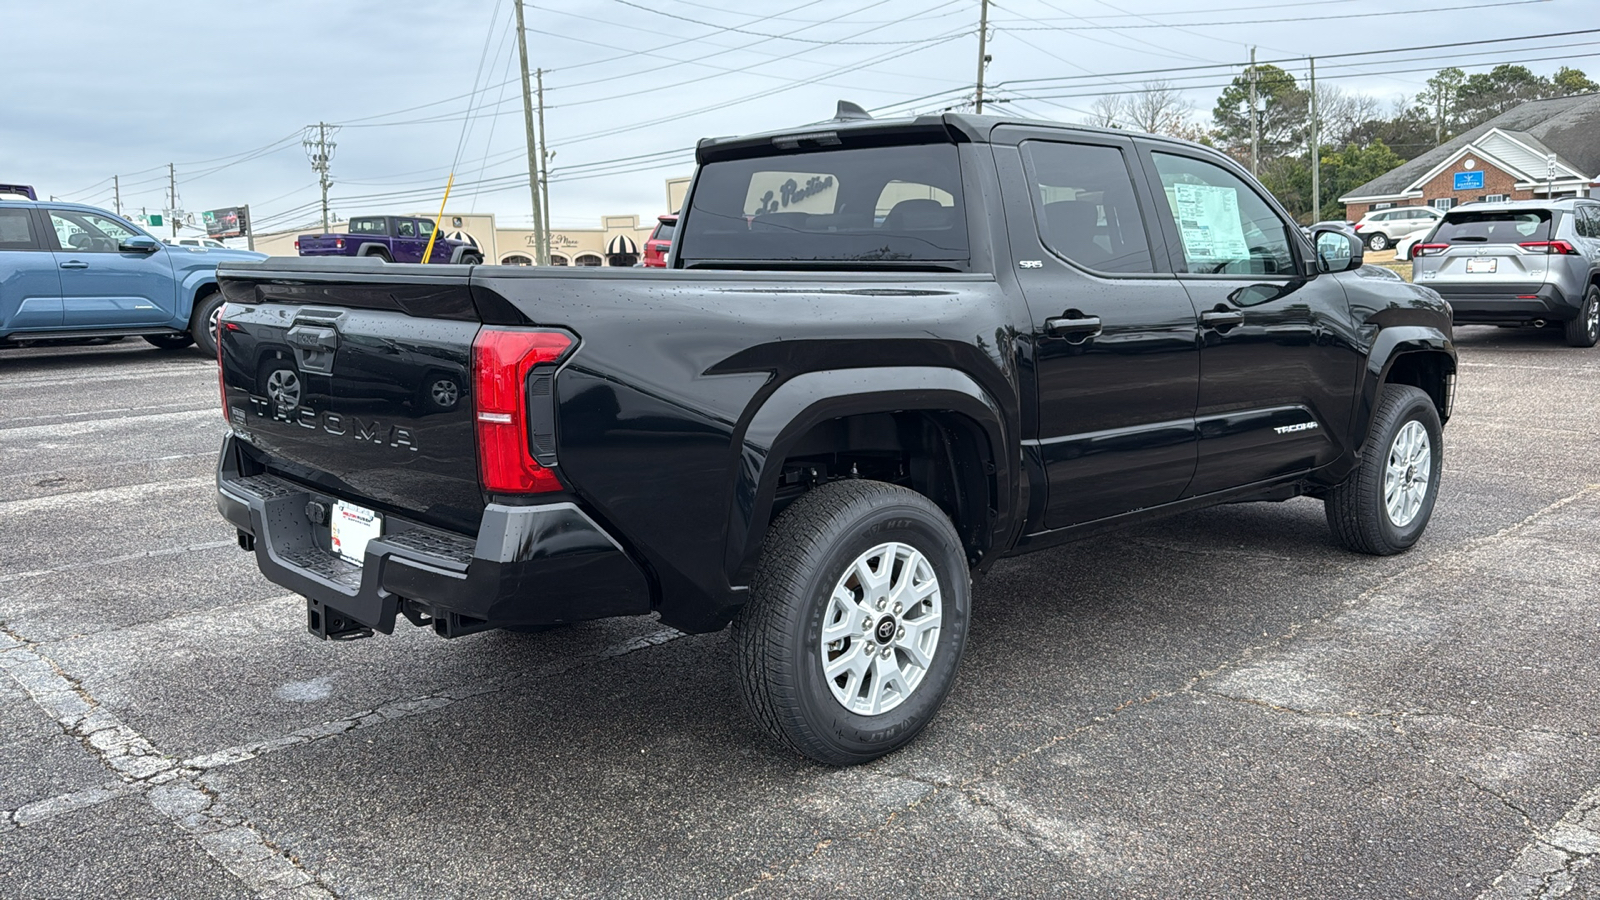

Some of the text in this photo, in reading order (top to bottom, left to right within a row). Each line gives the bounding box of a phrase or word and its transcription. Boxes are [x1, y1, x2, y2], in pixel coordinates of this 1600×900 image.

[1548, 167, 1556, 177] 35
[1019, 260, 1043, 269] SR5
[249, 394, 418, 451] TACOMA
[1273, 421, 1318, 434] TACOMA
